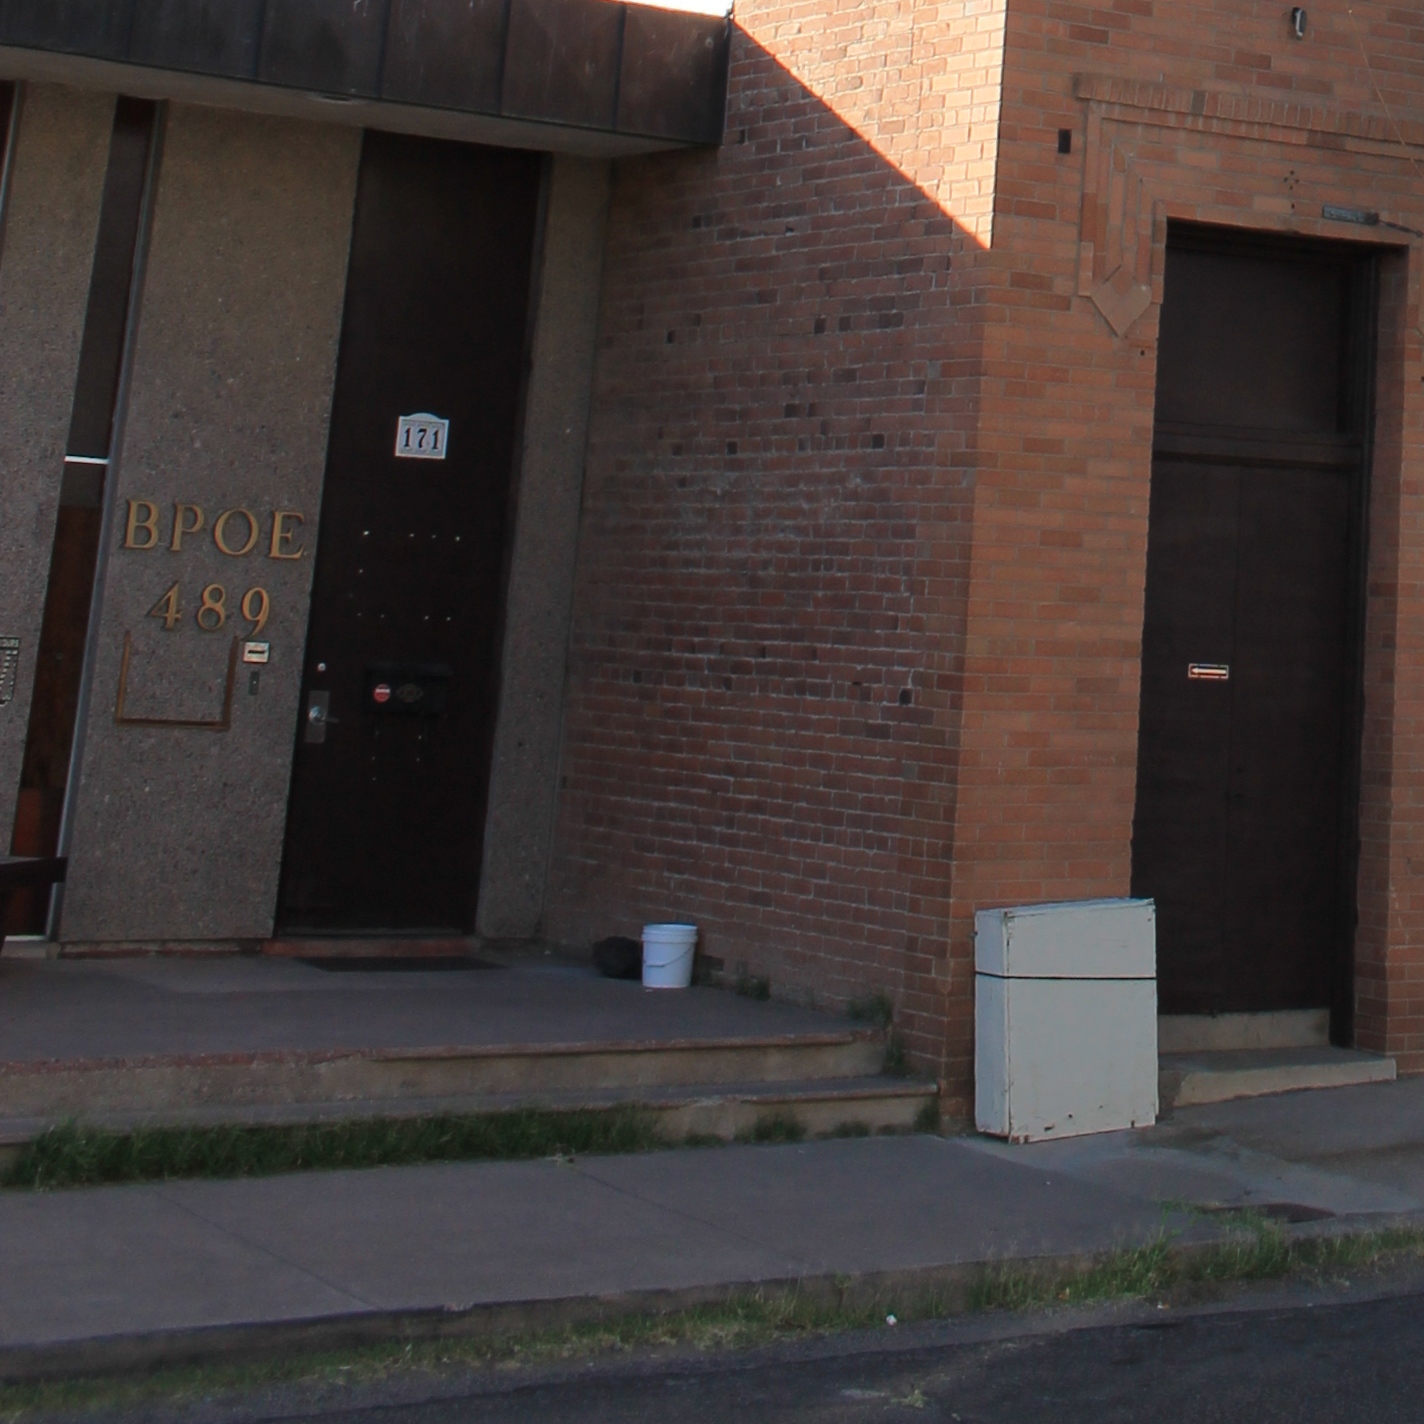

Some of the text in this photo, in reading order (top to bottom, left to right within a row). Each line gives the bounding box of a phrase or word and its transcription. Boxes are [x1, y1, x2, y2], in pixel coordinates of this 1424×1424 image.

[402, 426, 440, 450] 171
[122, 499, 305, 560] BPOE
[150, 581, 270, 637] 489
